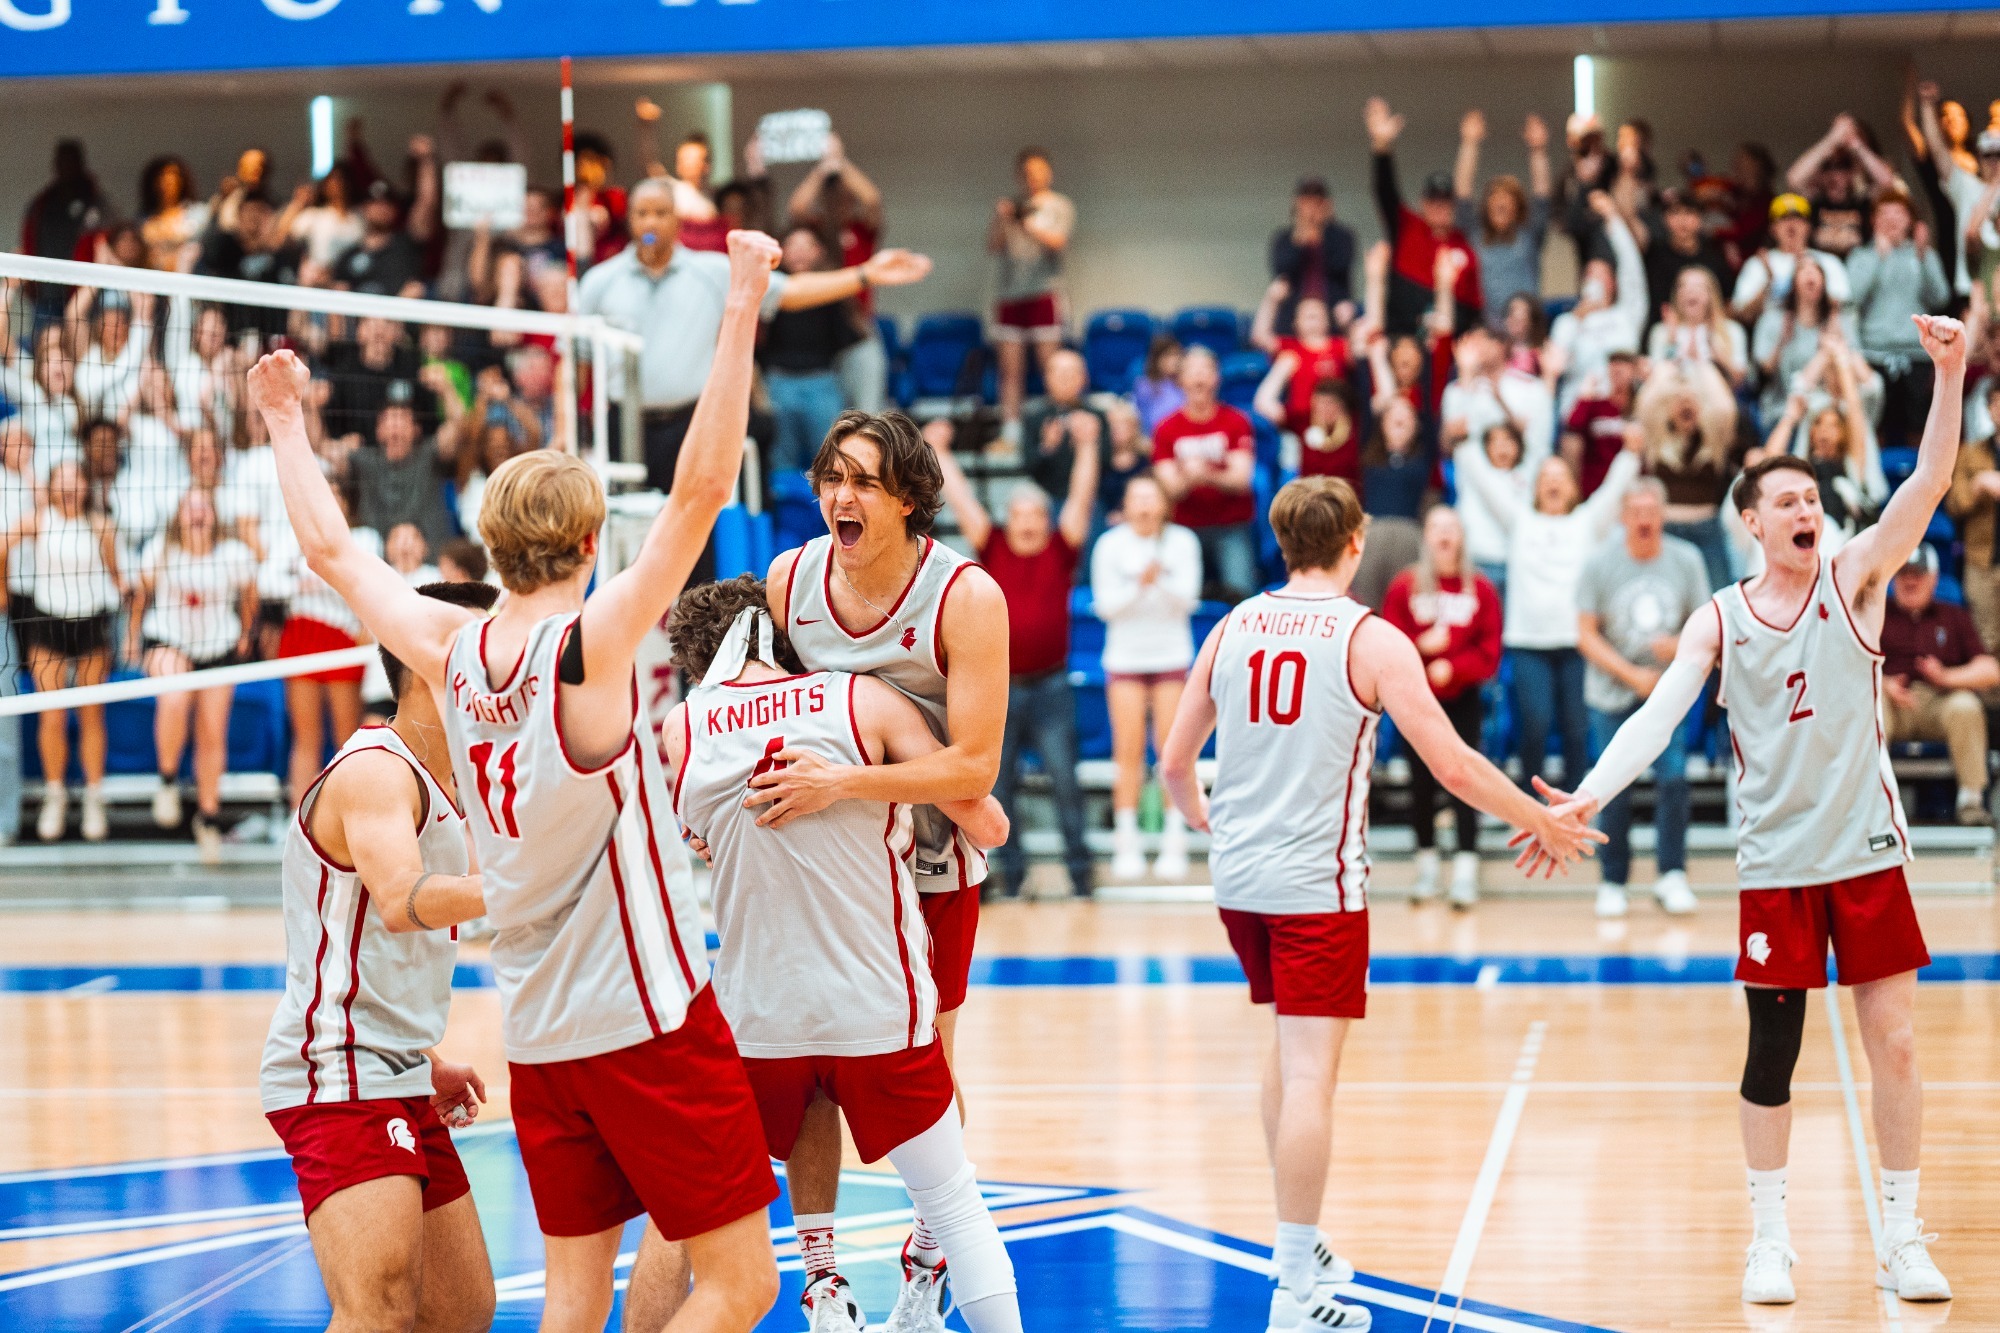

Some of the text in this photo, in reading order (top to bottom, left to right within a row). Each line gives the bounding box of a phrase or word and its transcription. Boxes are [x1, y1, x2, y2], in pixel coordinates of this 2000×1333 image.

[1238, 612, 1338, 639] KNIGHTS
[706, 683, 826, 737] KNIGHTS
[1247, 649, 1308, 727] 10
[1785, 671, 1814, 723] 2
[468, 740, 521, 839] 11
